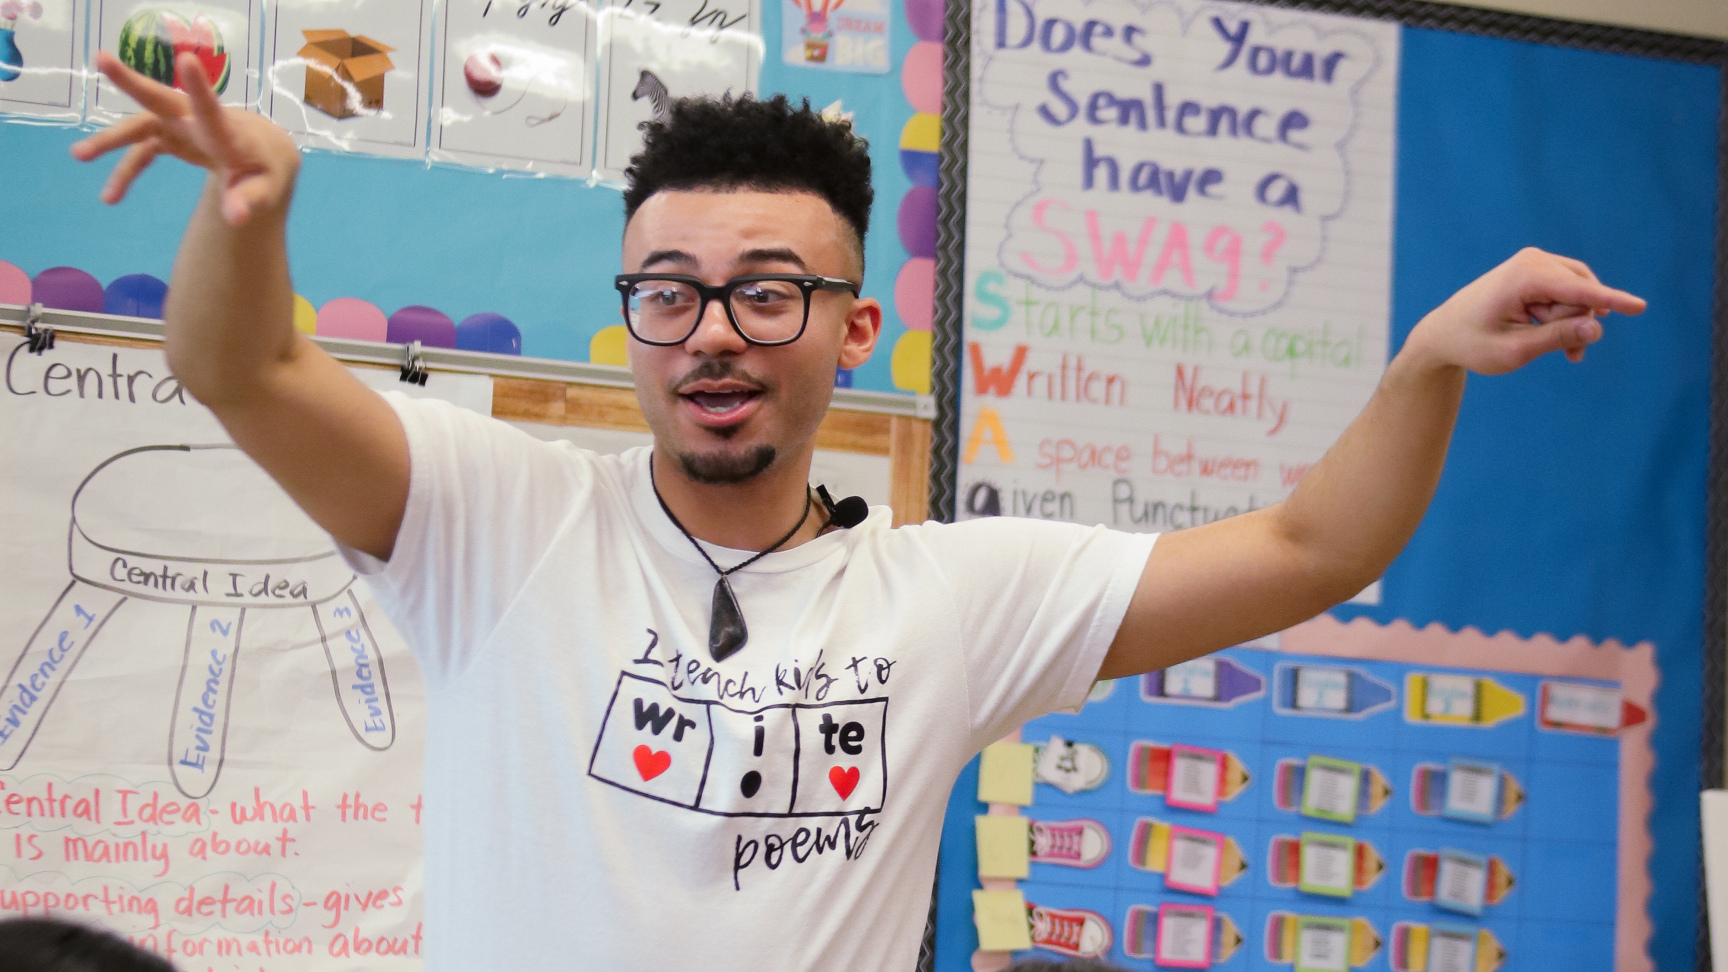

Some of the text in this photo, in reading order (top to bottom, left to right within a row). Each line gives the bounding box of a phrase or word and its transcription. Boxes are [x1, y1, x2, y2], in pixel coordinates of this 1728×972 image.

[835, 35, 886, 67] BIG
[994, 0, 1349, 83] Does Your
[1081, 137, 1303, 214] have a
[970, 270, 1366, 381] Starts with a capital
[6, 336, 186, 405] Centra
[968, 342, 1289, 437] Written Neatly
[962, 405, 1014, 464] A
[1035, 437, 1131, 484] space
[1152, 433, 1260, 482] between
[110, 557, 308, 600] Central Idea
[74, 604, 96, 630] 1
[180, 618, 232, 773] Evidence 2
[334, 606, 386, 734] Evidence 3
[668, 649, 766, 703] teach
[775, 649, 838, 701] kids
[845, 656, 896, 694] to
[753, 714, 765, 757] i
[819, 713, 865, 755] te
[0, 782, 101, 825] entral
[230, 786, 316, 826] what
[336, 791, 389, 825] the
[64, 831, 170, 877] mainly
[189, 828, 299, 861] about.
[734, 807, 879, 891] poems
[0, 884, 160, 929] upporting
[328, 922, 423, 958] about
